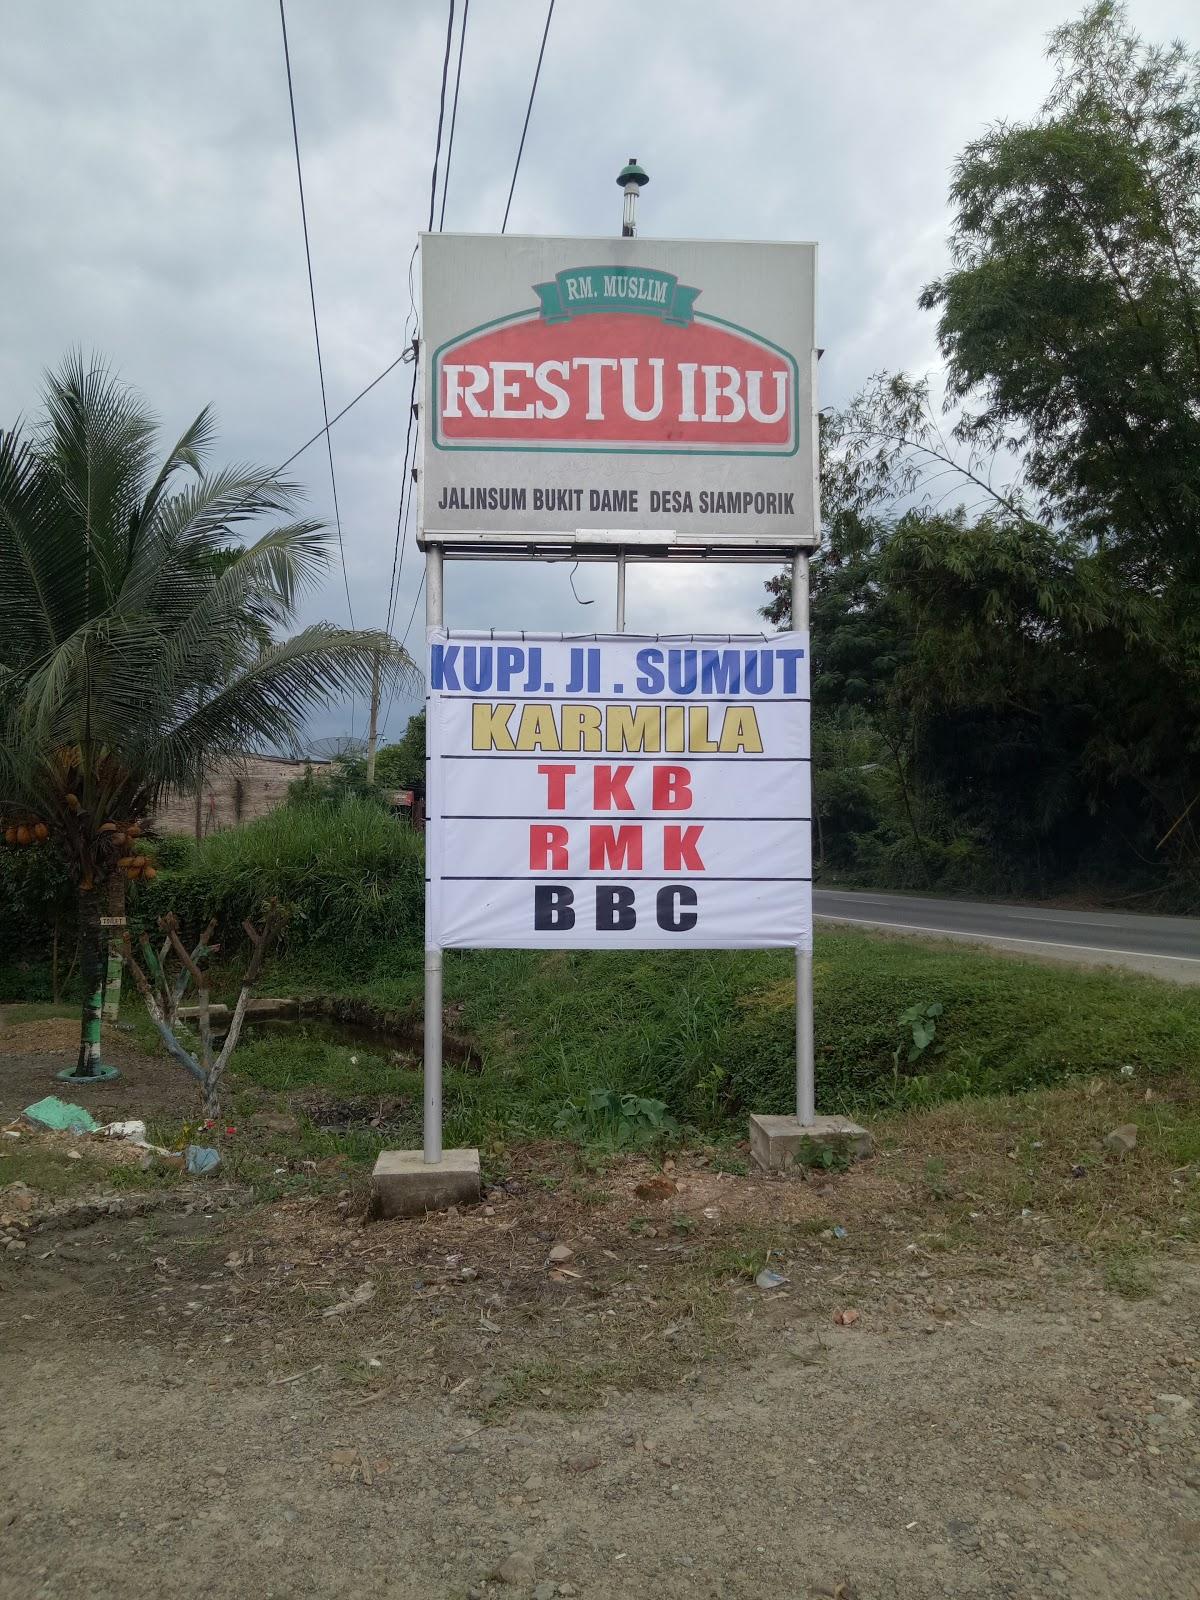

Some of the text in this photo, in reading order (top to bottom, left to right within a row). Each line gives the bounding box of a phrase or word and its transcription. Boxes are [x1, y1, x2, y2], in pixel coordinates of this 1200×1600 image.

[566, 275, 667, 304] RM. MUSLIM
[442, 358, 788, 424] RESTU IBU
[438, 487, 794, 515] JALINSUM BUKIT DAME DESA SIAMPORIK
[431, 644, 554, 693] KUPJ.
[636, 648, 804, 695] SUMUT
[472, 703, 764, 753] KARMILA
